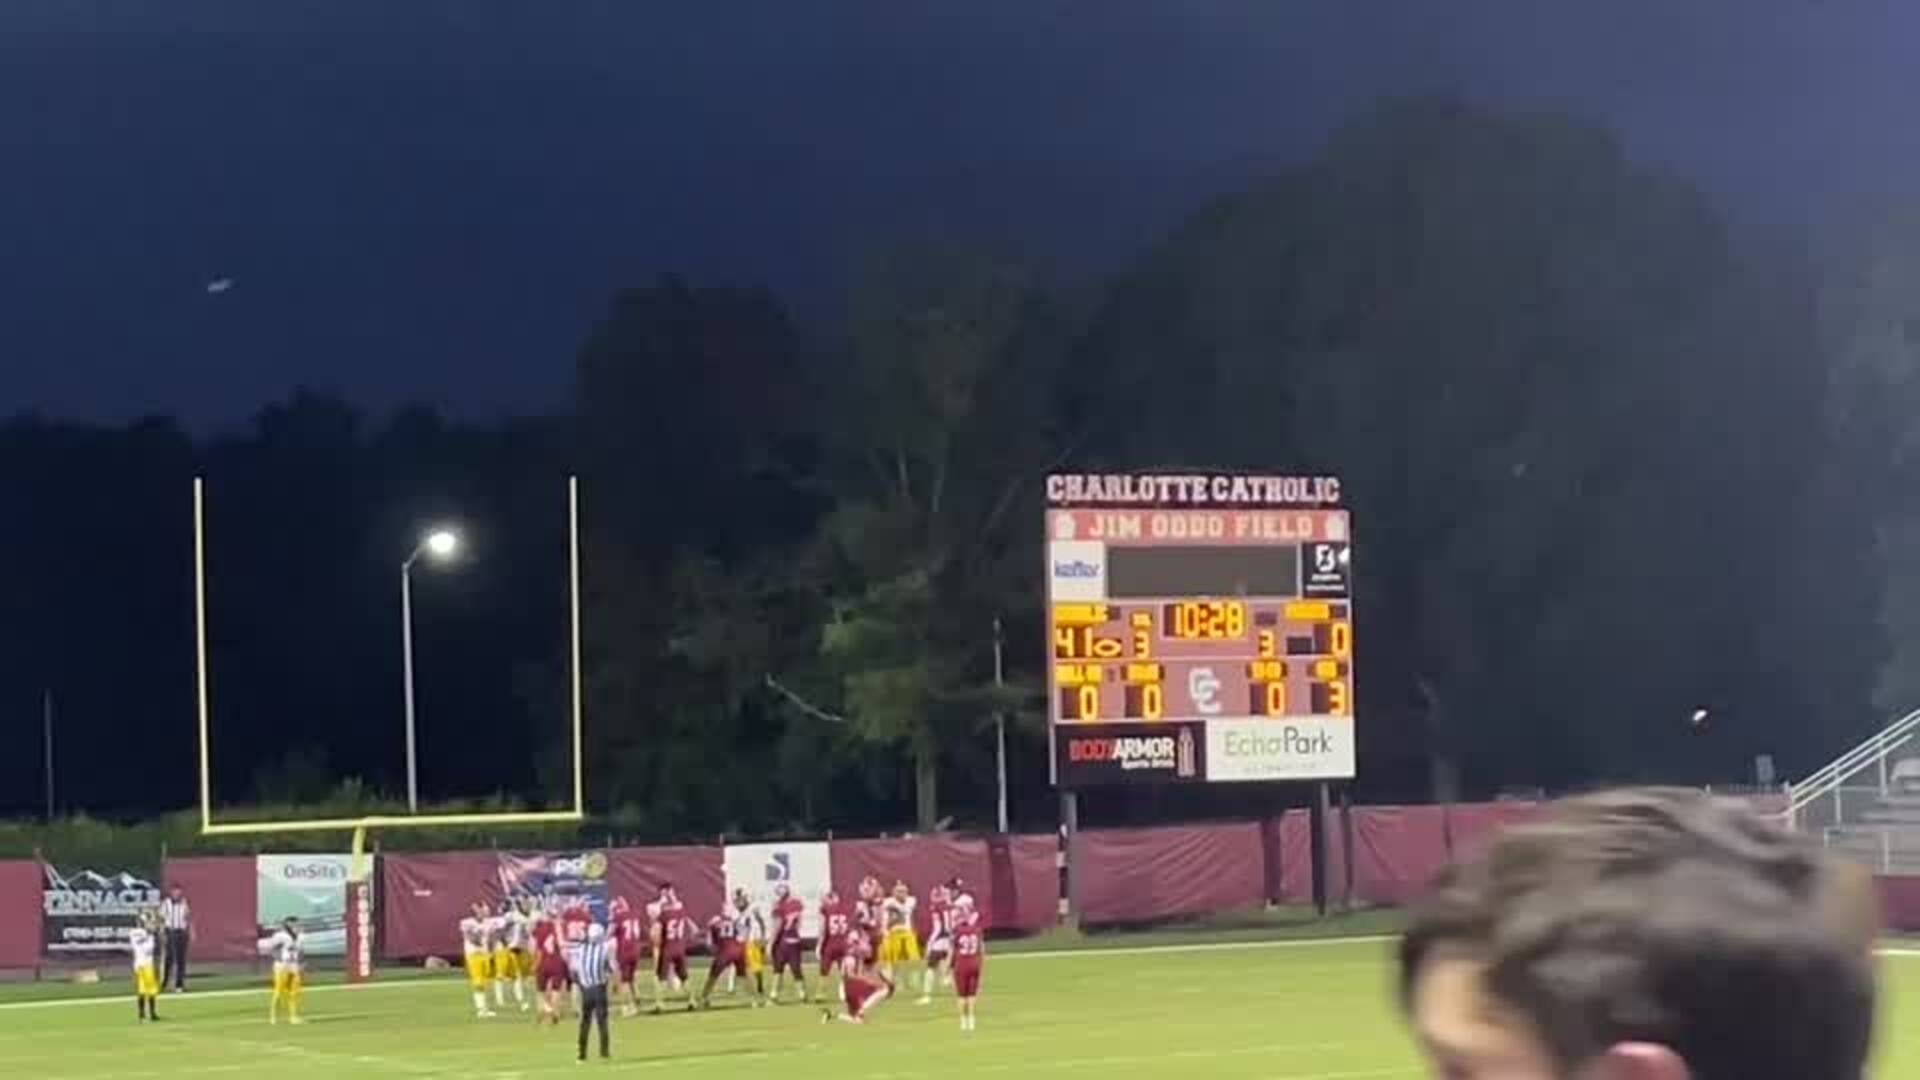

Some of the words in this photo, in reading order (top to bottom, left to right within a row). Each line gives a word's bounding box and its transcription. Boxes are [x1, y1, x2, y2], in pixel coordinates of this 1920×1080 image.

[1046, 475, 1208, 502] CHARLOTTE
[1212, 475, 1340, 502] CATHOLIC
[1089, 514, 1141, 538] JIM
[1151, 514, 1224, 538] ODDO
[1234, 514, 1314, 539] FIELD
[1174, 602, 1243, 637] 10:28
[1056, 627, 1093, 658] 41
[1135, 631, 1150, 659] 3
[1259, 629, 1275, 657] 3
[1332, 623, 1348, 656] 0
[1080, 685, 1098, 720] 0
[1144, 684, 1161, 719] 0
[1267, 681, 1285, 716] 0
[1329, 681, 1346, 714] 3
